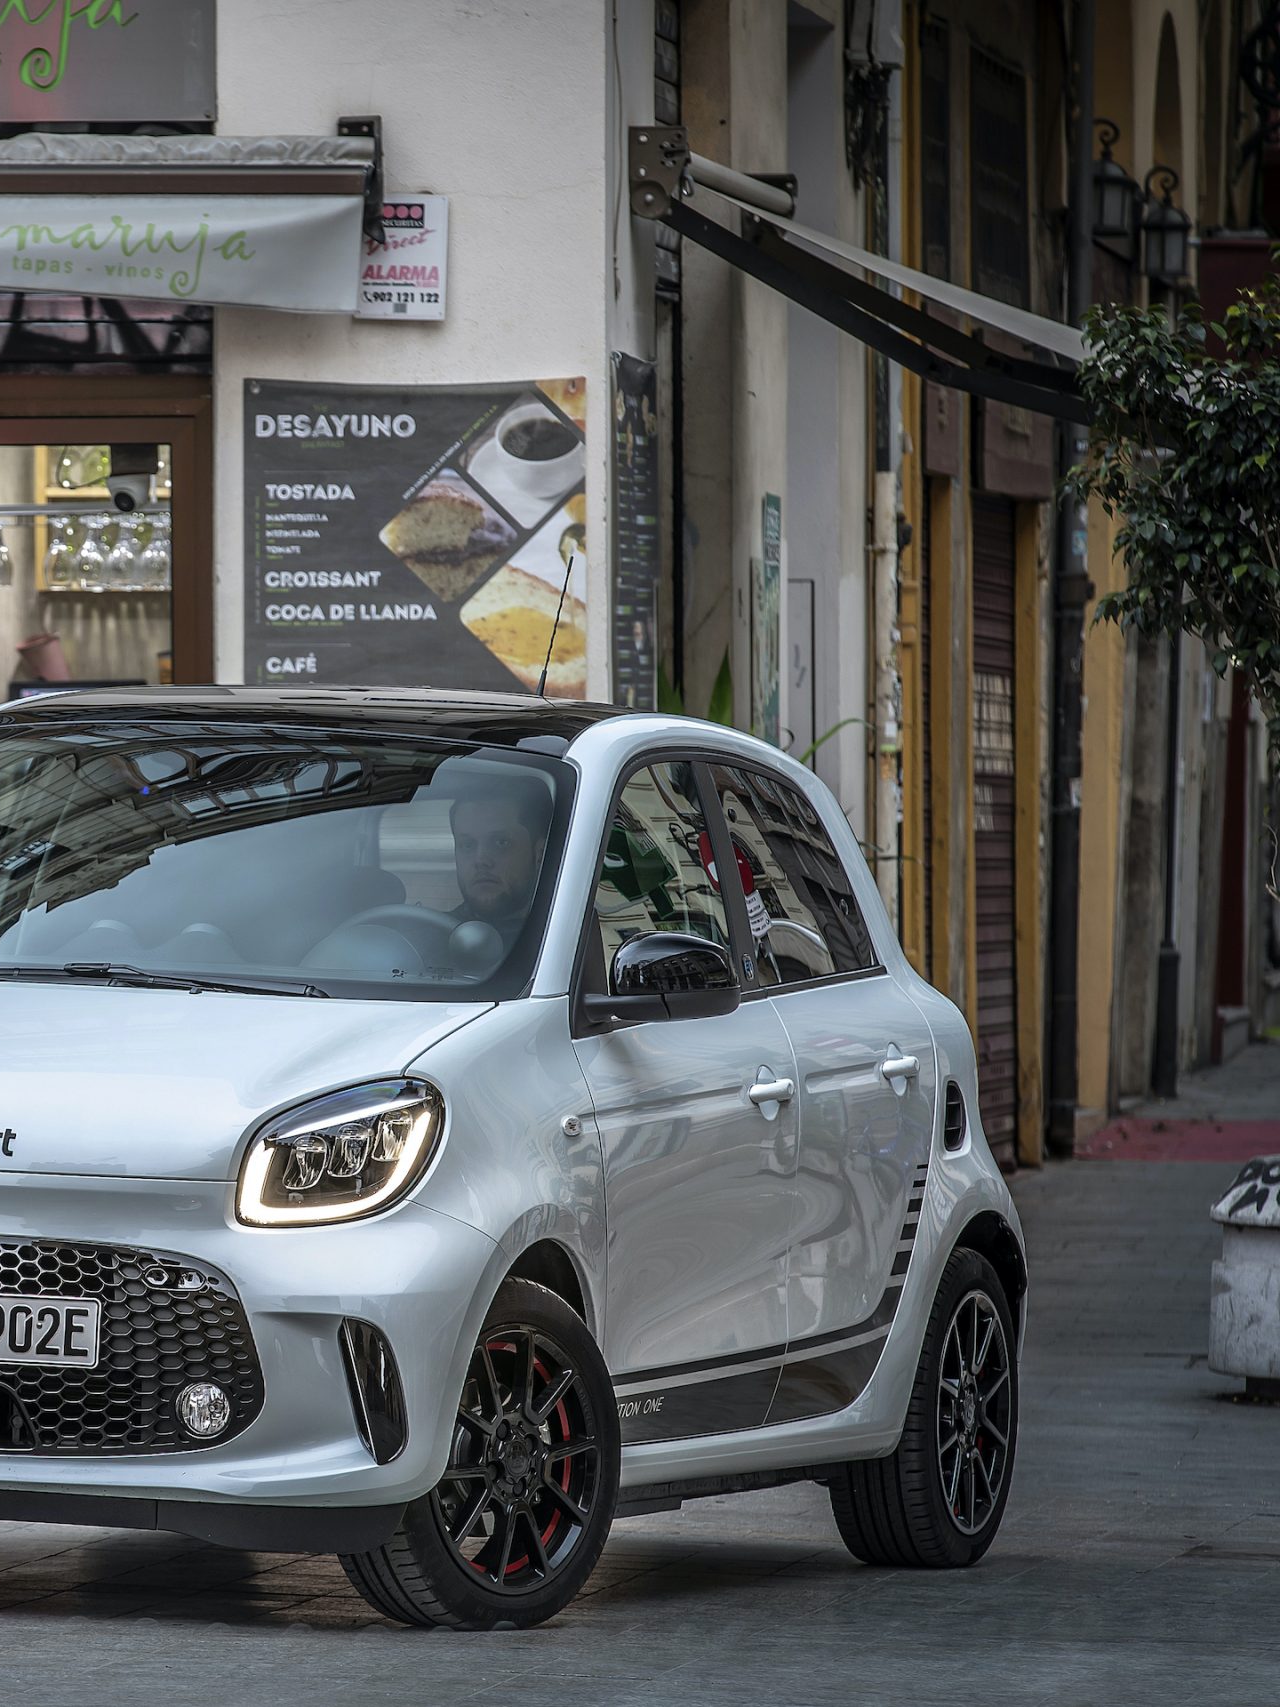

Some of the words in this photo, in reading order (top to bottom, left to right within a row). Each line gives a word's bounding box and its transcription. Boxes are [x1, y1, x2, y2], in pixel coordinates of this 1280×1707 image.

[0, 212, 256, 298] maruja
[11, 255, 74, 274] tapas
[104, 262, 164, 280] vinos
[362, 263, 439, 281] ALARMA
[397, 292, 416, 303] 121
[420, 292, 439, 304] 122
[255, 413, 417, 438] DESAYUNO
[265, 483, 357, 501] TOSTADA
[264, 570, 382, 588] CROISSANT
[265, 603, 326, 621] COCA
[329, 604, 356, 620] DE
[360, 603, 438, 621] LLANDA
[265, 652, 318, 674] CAFÉ
[617, 1400, 642, 1418] TION
[643, 1396, 665, 1414] ONE
